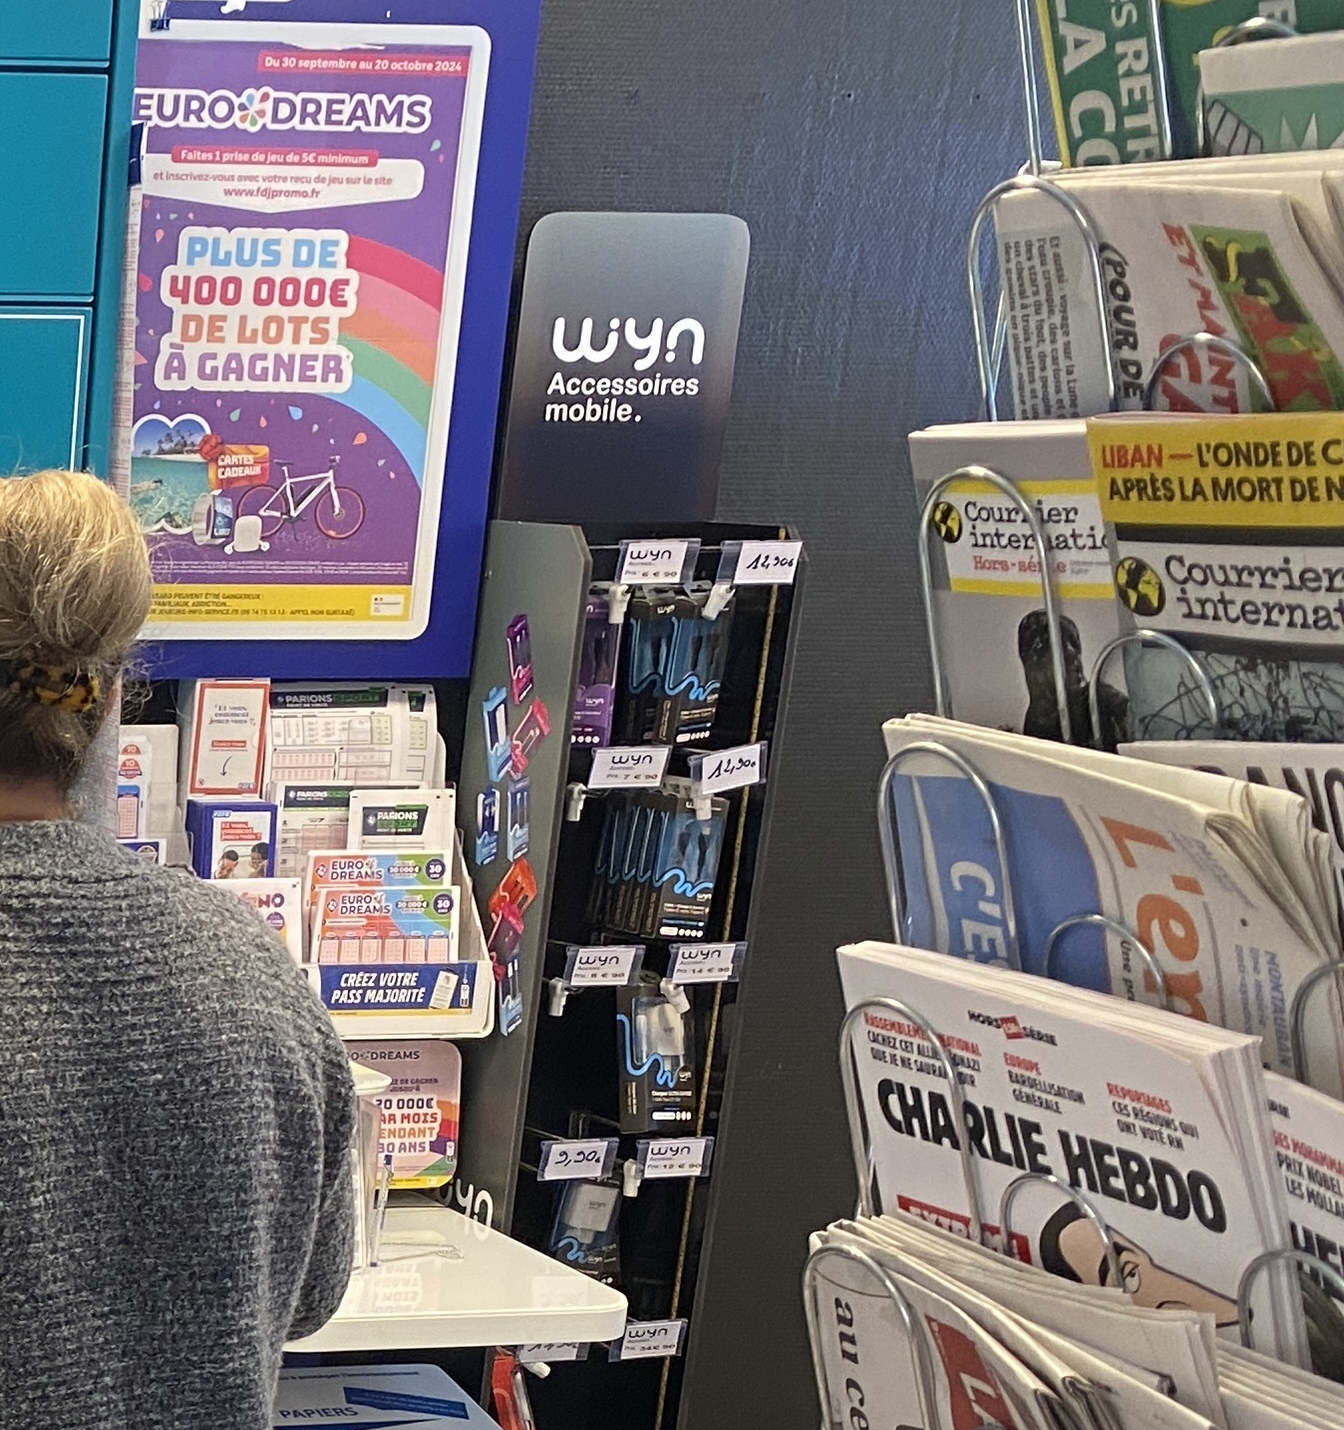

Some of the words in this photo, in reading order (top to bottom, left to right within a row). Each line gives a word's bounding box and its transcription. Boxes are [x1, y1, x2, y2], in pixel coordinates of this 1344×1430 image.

[264, 56, 279, 69] Du
[281, 57, 296, 69] 30
[296, 57, 358, 73] septembre
[359, 60, 373, 71] au
[374, 60, 388, 71] 20
[389, 60, 432, 73] octobre
[433, 60, 463, 73] 2024
[180, 150, 213, 163] Faites
[223, 151, 250, 166] prise
[251, 152, 266, 164] de
[266, 152, 285, 167] jeu
[286, 153, 300, 165] de
[318, 153, 369, 165] minimum
[165, 172, 234, 184] inscrivez-vous
[313, 175, 326, 186] de
[374, 175, 393, 186] site
[224, 186, 321, 200] www.fdjpromo.fr
[186, 237, 281, 267] PLUS
[292, 239, 339, 268] DE
[169, 275, 245, 306] 400
[253, 277, 350, 307] 000€
[180, 314, 229, 344] DE
[237, 316, 330, 345] LOTS
[552, 317, 705, 371] wyn
[163, 343, 187, 381] À
[198, 352, 345, 383] GAGNER
[547, 372, 699, 396] Accessoires
[544, 399, 643, 422] mobile.
[217, 454, 255, 466] CARTES
[1102, 443, 1164, 469] LIBAN
[1196, 441, 1282, 469] L'ONDE
[1287, 440, 1315, 466] DE
[217, 465, 262, 479] CADEAUX
[1108, 472, 1176, 501] APRÈS
[1179, 476, 1208, 502] LA
[1212, 475, 1286, 501] MORT
[1294, 476, 1320, 501] DE
[1165, 554, 1344, 592] Courrier
[285, 693, 332, 704] PARIONS
[377, 811, 419, 821] PARIONS
[332, 860, 363, 870] EURO
[331, 870, 383, 880] DREAMS
[341, 895, 373, 905] EURO
[340, 905, 391, 915] DREAMS
[340, 970, 375, 987] CRÉEZ
[379, 972, 418, 986] VOTRE
[331, 989, 363, 1004] PASS
[365, 988, 426, 1004] MAJORITÉ
[396, 1098, 434, 1110] 000€
[401, 1112, 438, 1124] MOIS
[379, 1127, 436, 1139] ENDANT
[399, 1141, 426, 1153] ANS
[877, 1078, 1053, 1175] CHARLIE
[1058, 1129, 1228, 1235] HEBDO
[833, 1296, 859, 1363] au
[280, 1406, 359, 1420] PAPIERS
